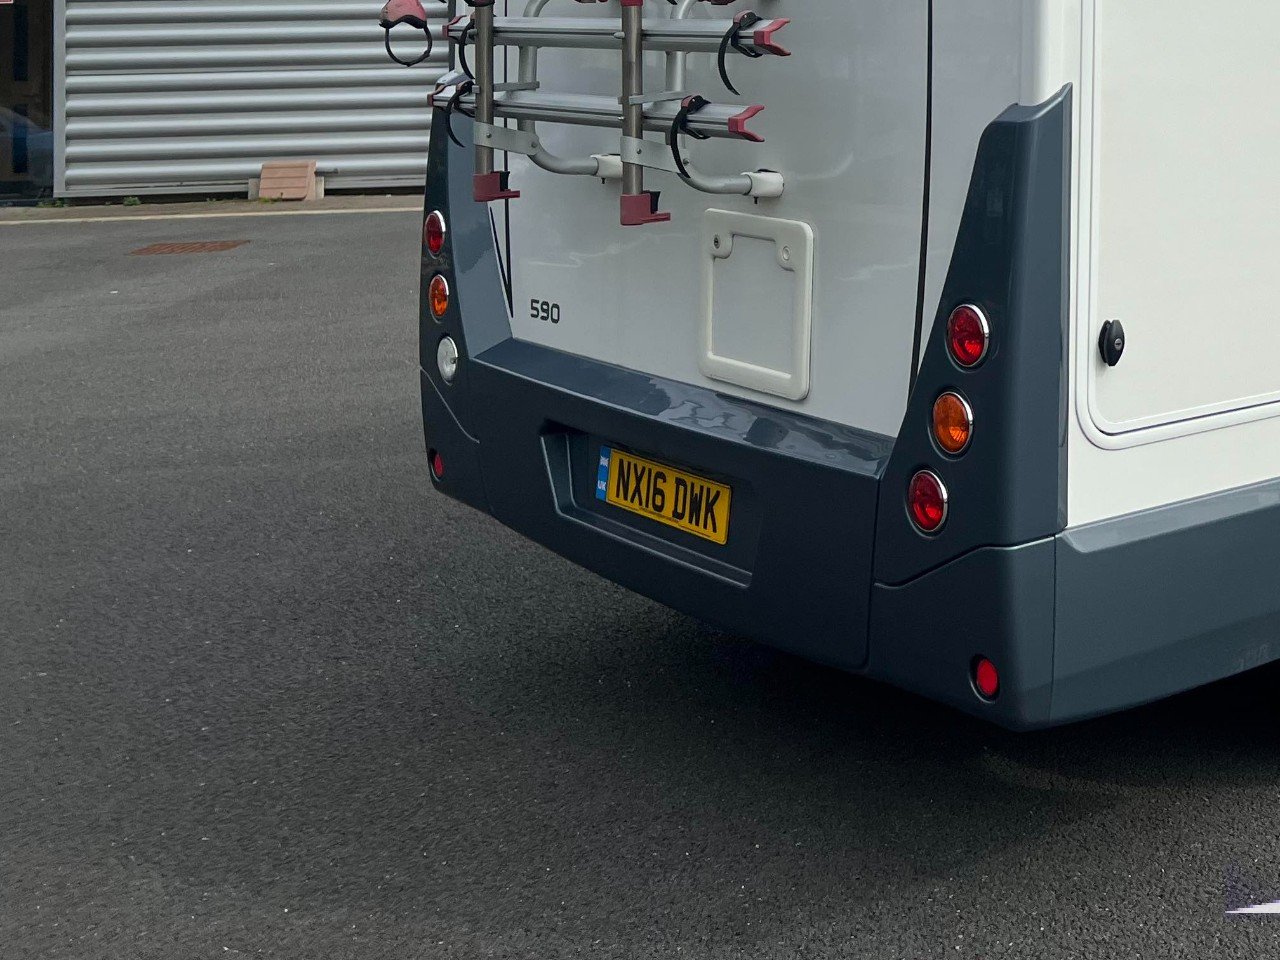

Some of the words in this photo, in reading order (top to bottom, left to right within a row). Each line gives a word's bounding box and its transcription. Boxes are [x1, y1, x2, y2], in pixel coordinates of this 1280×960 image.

[530, 298, 561, 324] 590
[615, 458, 667, 513] NX16
[672, 476, 721, 534] DWK
